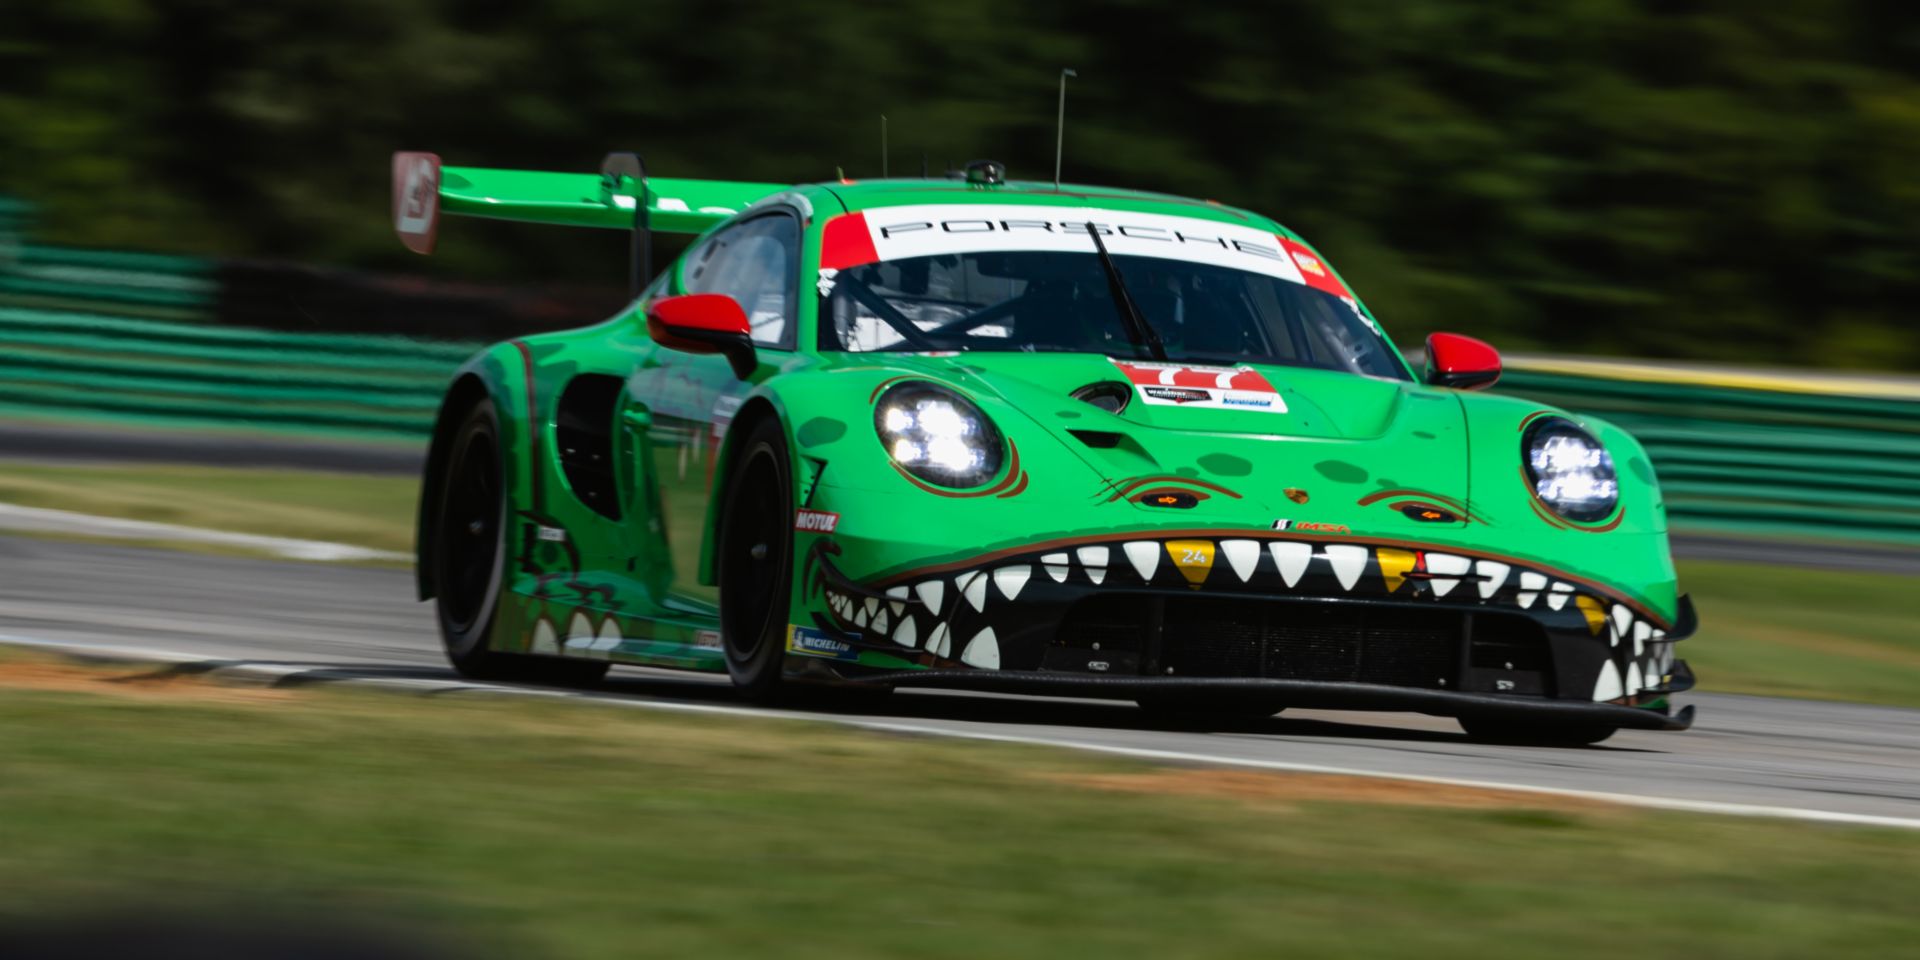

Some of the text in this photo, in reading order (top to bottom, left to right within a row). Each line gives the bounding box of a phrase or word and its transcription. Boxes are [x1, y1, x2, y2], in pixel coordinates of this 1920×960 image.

[881, 219, 1283, 262] PORSCHE
[796, 511, 836, 532] MOTUL
[1182, 549, 1206, 563] 24
[804, 636, 850, 652] MICHELIN
